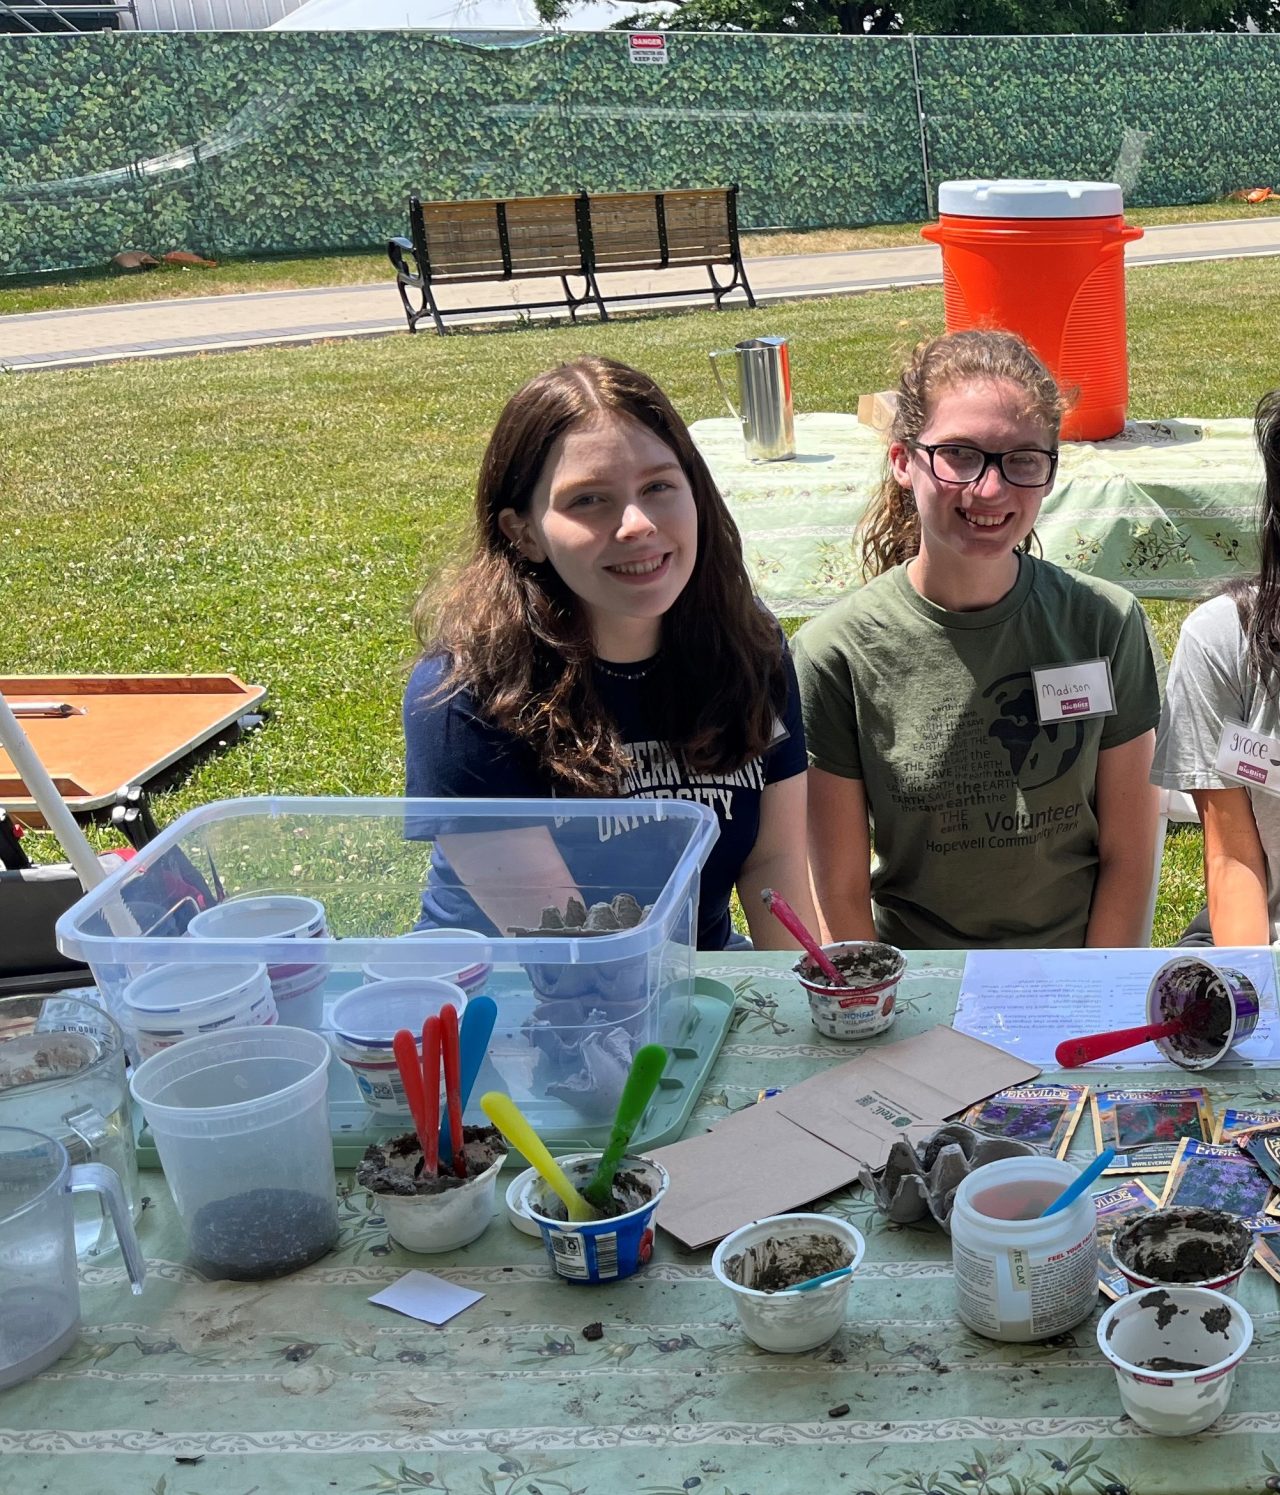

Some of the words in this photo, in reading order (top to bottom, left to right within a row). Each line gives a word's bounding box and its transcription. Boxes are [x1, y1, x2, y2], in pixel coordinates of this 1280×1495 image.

[1041, 682, 1092, 699] Madison
[1229, 732, 1269, 760] grace
[924, 768, 953, 780] SAVE
[994, 768, 1012, 778] the
[955, 781, 982, 795] the
[982, 778, 1020, 792] EARTH
[945, 792, 986, 809] earth
[940, 809, 970, 823] THE
[984, 802, 1084, 833] Volunteer
[940, 822, 970, 834] earth
[926, 836, 986, 855] Hopewell
[988, 827, 1055, 849] Community
[1056, 819, 1080, 835] Park
[843, 1010, 875, 1020] NONFAT
[1047, 1252, 1065, 1263] FEEL
[1066, 1243, 1083, 1255] YOUR
[1015, 1264, 1027, 1286] CLAY
